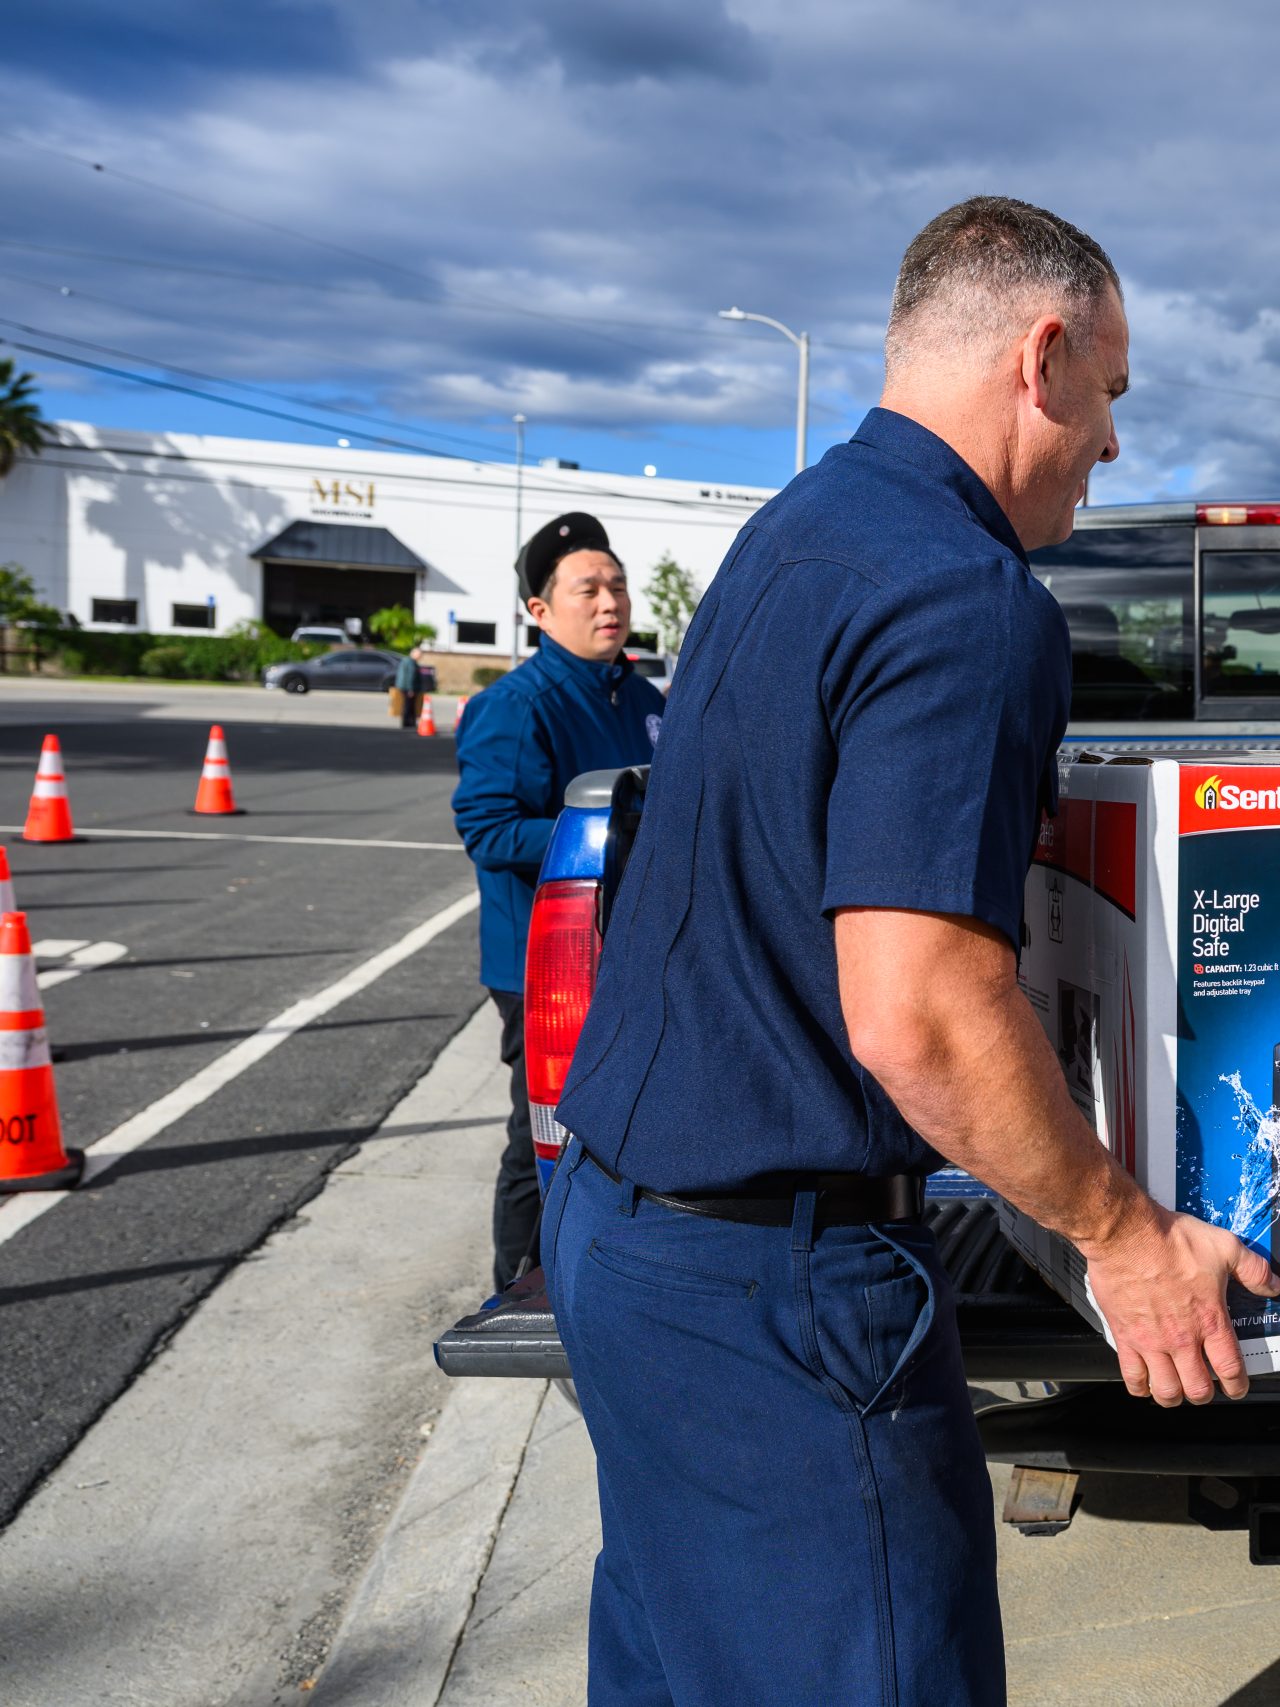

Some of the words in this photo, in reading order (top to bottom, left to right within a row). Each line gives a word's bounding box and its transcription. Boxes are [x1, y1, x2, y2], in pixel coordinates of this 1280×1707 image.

[310, 477, 374, 507] MSI
[1193, 889, 1260, 914] X-Large
[1193, 912, 1245, 938] Digital
[1192, 936, 1230, 957] Safe
[1205, 964, 1242, 974] CAPACITY:
[1244, 963, 1257, 972] 1.23
[1257, 963, 1273, 972] cubic
[1274, 962, 1279, 971] ft
[1193, 980, 1221, 988] Features
[1222, 979, 1243, 987] backlit
[1243, 978, 1265, 987] keypad
[1193, 989, 1205, 997] and
[1206, 988, 1238, 997] adjustable
[1239, 988, 1252, 996] tray
